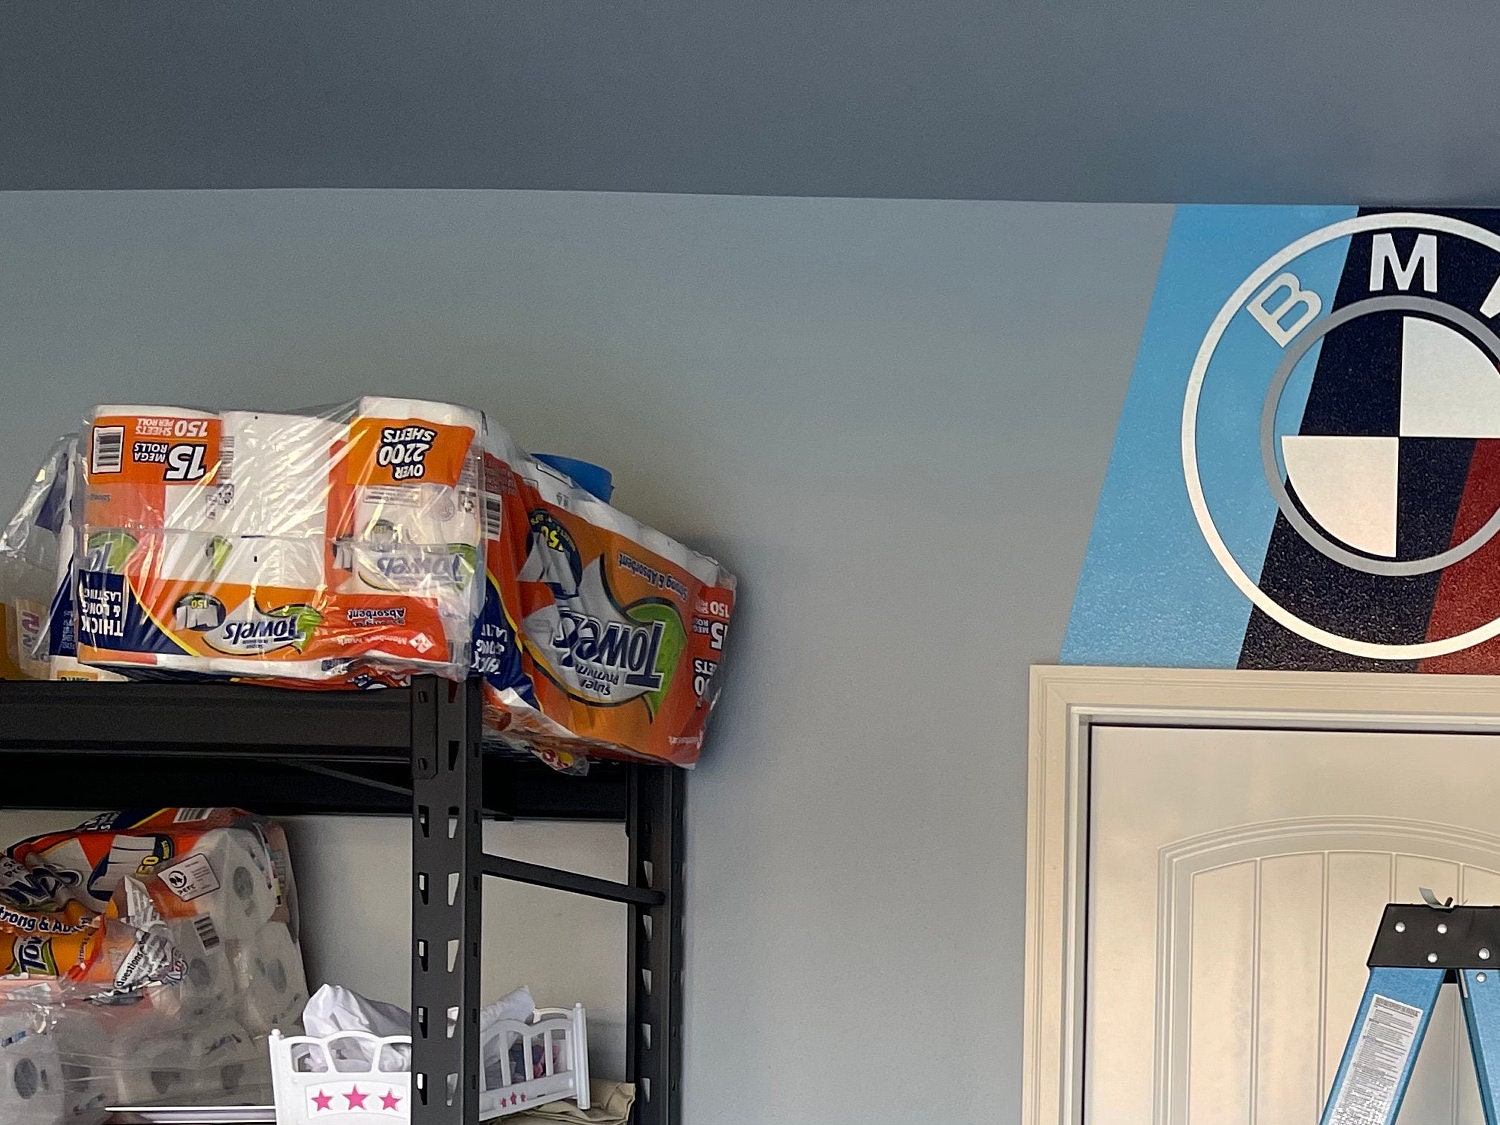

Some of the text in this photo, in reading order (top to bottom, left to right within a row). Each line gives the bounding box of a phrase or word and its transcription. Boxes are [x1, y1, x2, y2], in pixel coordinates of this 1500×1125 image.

[136, 417, 175, 427] PER ROLL
[174, 419, 208, 438] 150
[135, 425, 173, 437] SHEETS
[133, 442, 168, 453] ROLLS
[379, 442, 430, 467] 2200
[133, 452, 166, 463] MEGA
[165, 445, 205, 480] 15
[394, 464, 424, 479] OVER
[112, 604, 122, 618] &
[347, 607, 407, 621] Absorbent
[81, 615, 125, 638] THICK
[222, 612, 307, 646] Towels
[0, 904, 37, 932] trong
